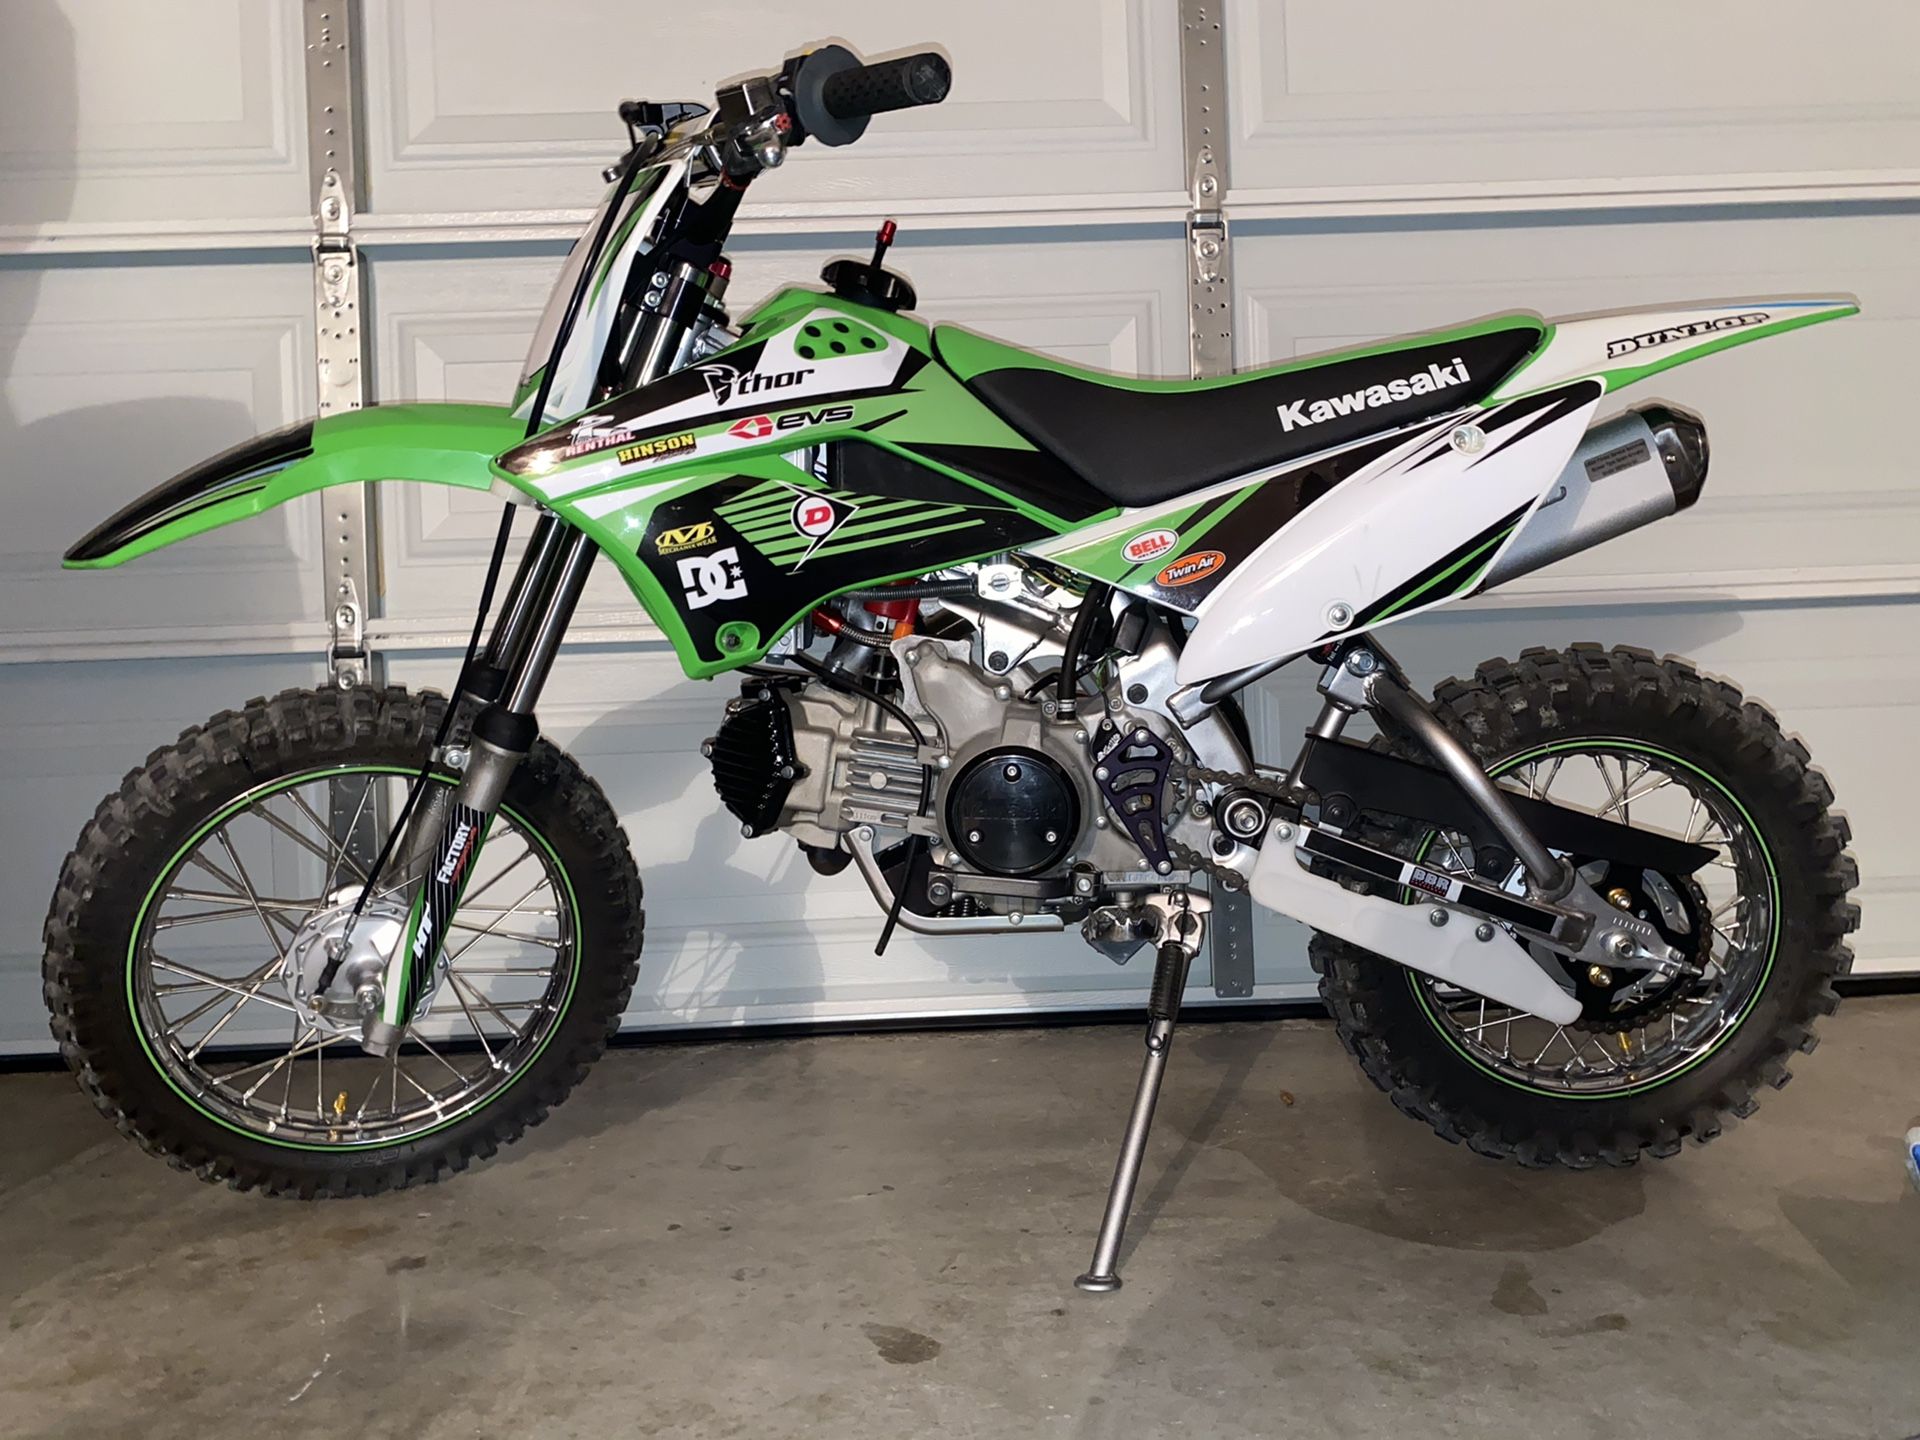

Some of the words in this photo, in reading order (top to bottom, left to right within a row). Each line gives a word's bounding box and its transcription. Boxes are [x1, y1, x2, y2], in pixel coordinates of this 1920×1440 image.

[1607, 312, 1770, 359] DUNLOP
[738, 369, 815, 395] thor
[1277, 357, 1471, 432] Kawasaki
[566, 431, 637, 457] RENTHAL
[618, 433, 695, 463] HINSON
[803, 506, 831, 527] D
[697, 535, 718, 547] WEAR
[1129, 535, 1170, 557] BELL
[676, 546, 748, 610] DC
[1166, 562, 1197, 581] Twin
[1197, 554, 1217, 570] Air
[436, 821, 471, 884] FACTORY
[1412, 868, 1450, 890] BBR
